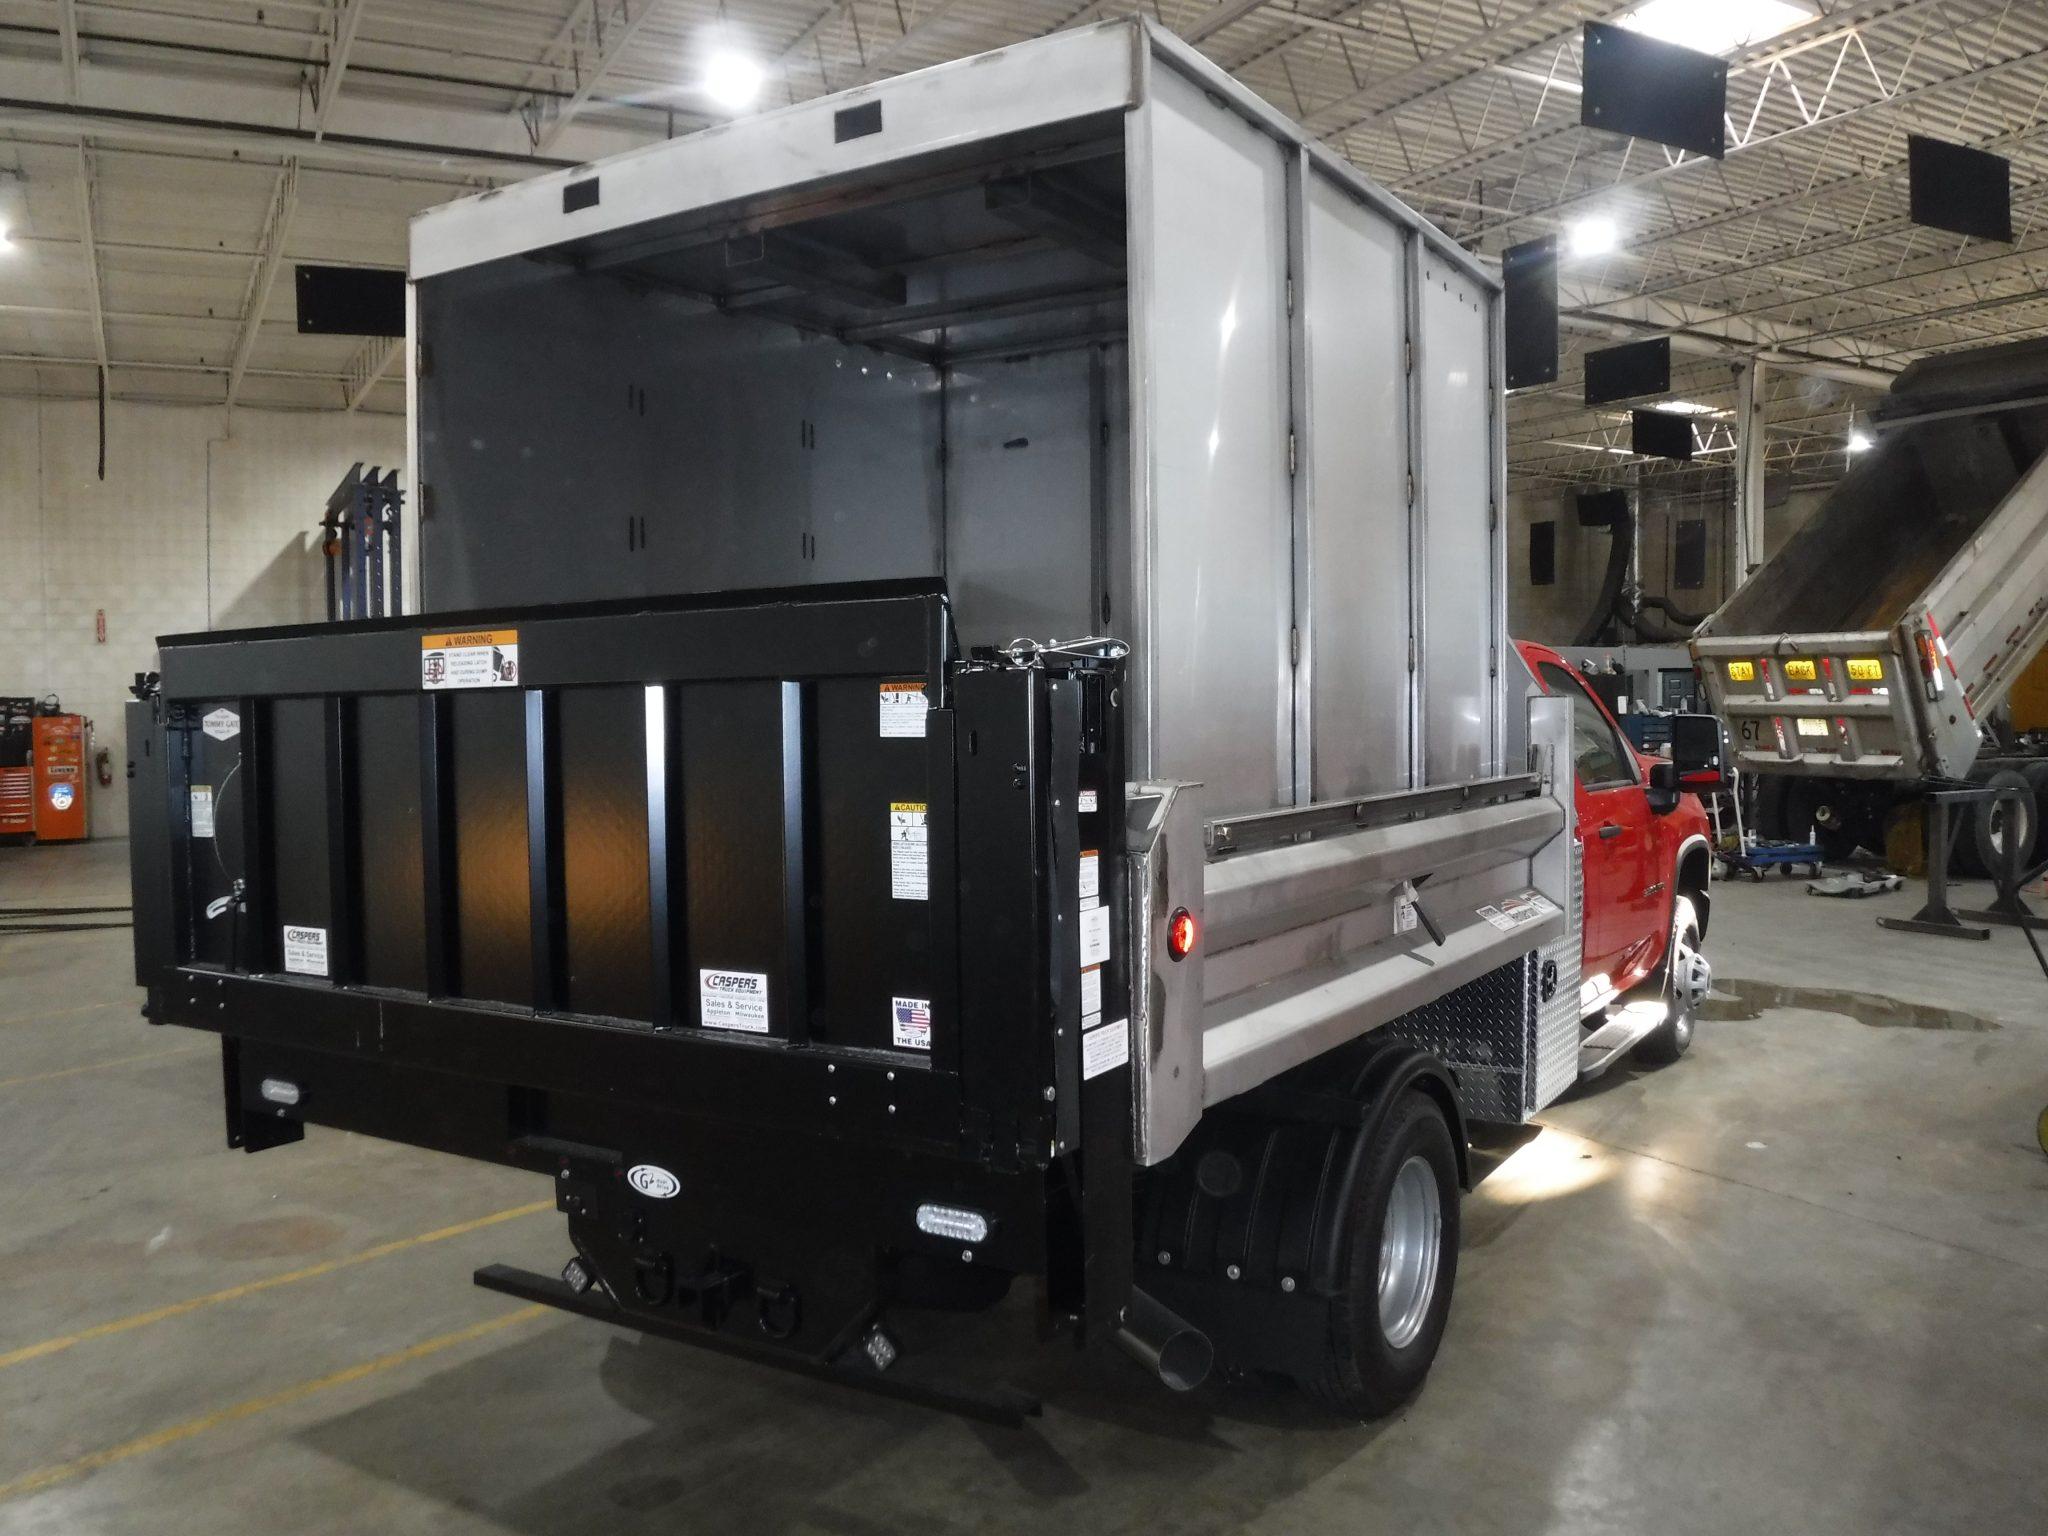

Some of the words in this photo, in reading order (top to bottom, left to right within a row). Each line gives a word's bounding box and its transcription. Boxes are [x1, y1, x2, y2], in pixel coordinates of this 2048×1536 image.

[454, 634, 493, 646] WARNING
[1730, 665, 1751, 678] STAY
[1788, 664, 1812, 677] BACK
[1741, 720, 1760, 741] 67
[900, 804, 927, 812] CAUTIO
[705, 998, 726, 1009] Sales
[727, 1000, 733, 1009] &
[735, 1001, 763, 1012] Service
[895, 1000, 919, 1009] MADE
[921, 1002, 930, 1010] IN
[896, 1037, 912, 1045] THE
[914, 1038, 930, 1047] USA
